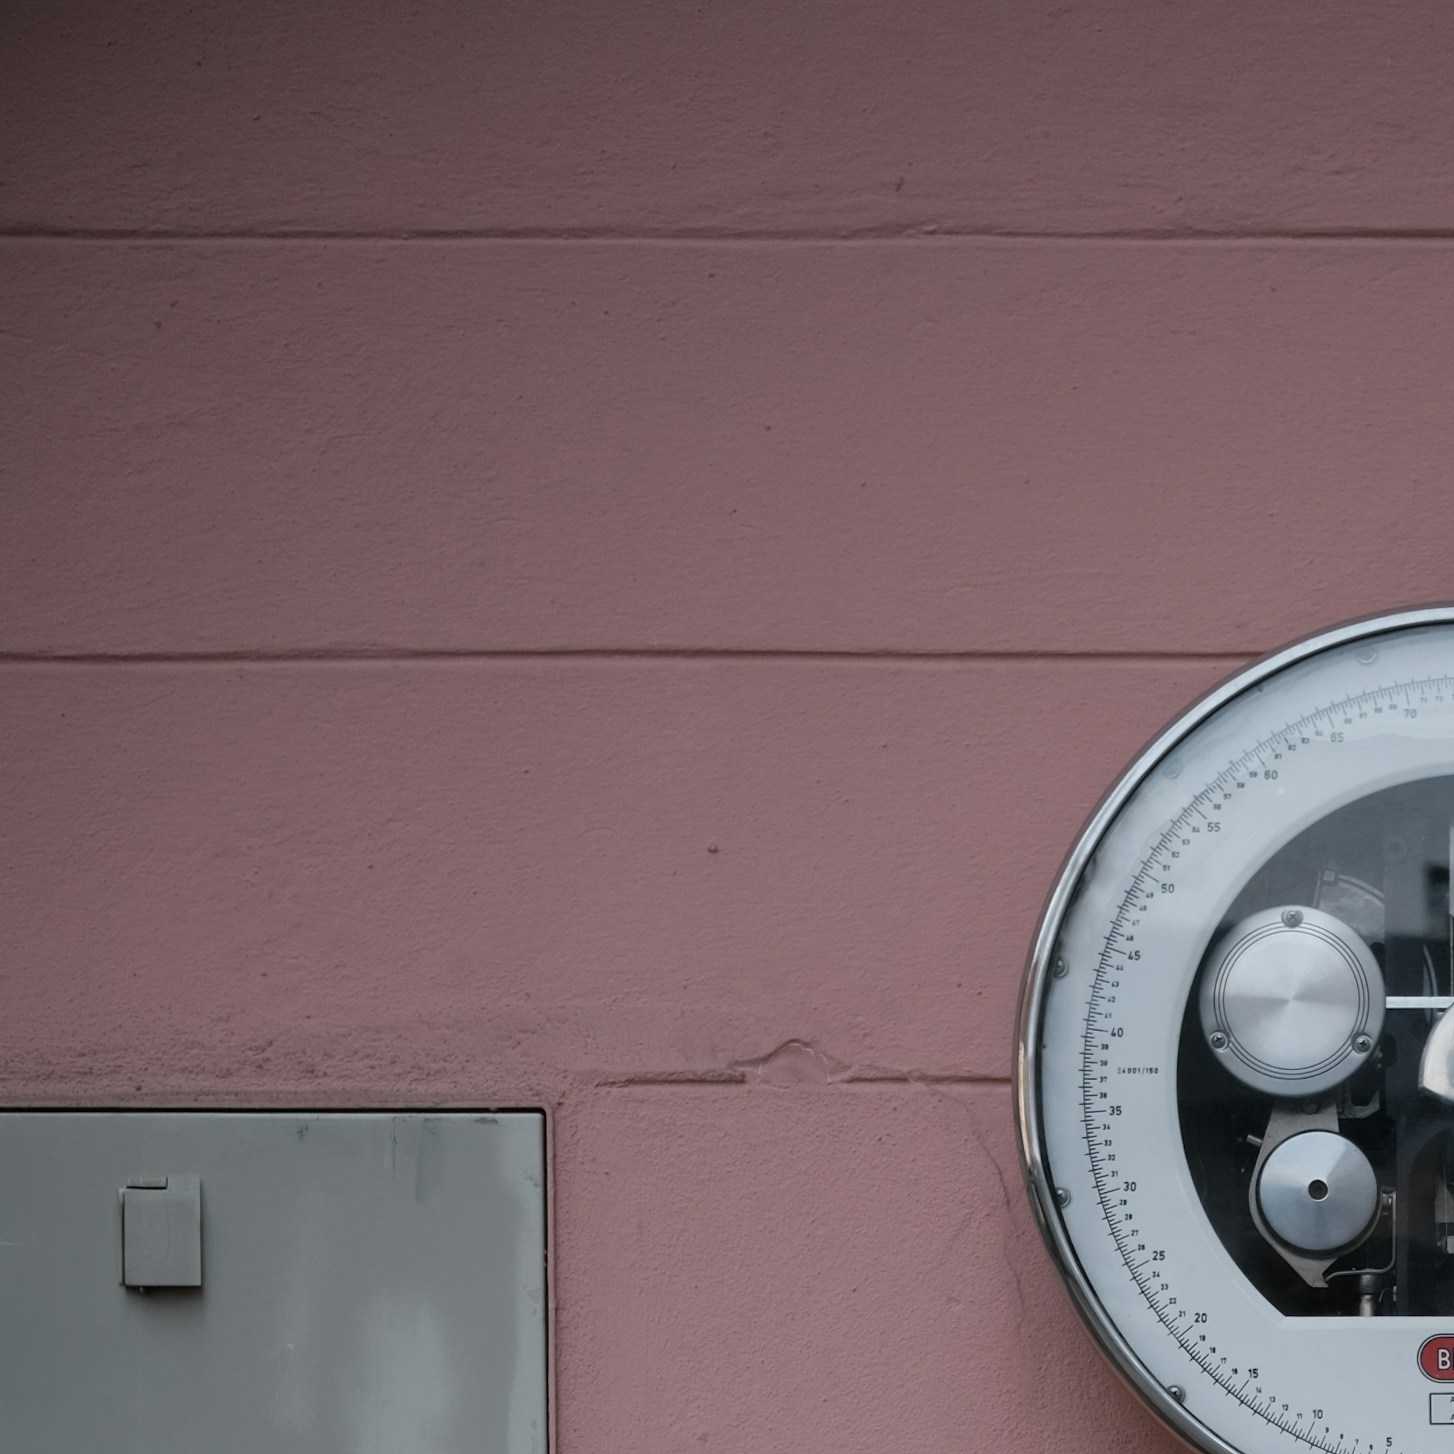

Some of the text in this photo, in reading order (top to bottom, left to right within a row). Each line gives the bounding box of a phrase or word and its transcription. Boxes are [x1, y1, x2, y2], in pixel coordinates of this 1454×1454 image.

[1404, 708, 1417, 719] 70
[1330, 732, 1344, 743] 65
[1264, 770, 1278, 780] 60
[1207, 822, 1220, 832] 55
[1161, 883, 1174, 893] 50
[1128, 950, 1140, 961] 45
[1111, 1027, 1123, 1038] 40
[1109, 1106, 1122, 1116] 35
[1124, 1181, 1136, 1192] 30
[1152, 1250, 1165, 1261] 25
[1195, 1313, 1207, 1323] 20
[1248, 1368, 1258, 1378] 15
[1313, 1409, 1323, 1419] 10
[1387, 1437, 1392, 1447] 5
